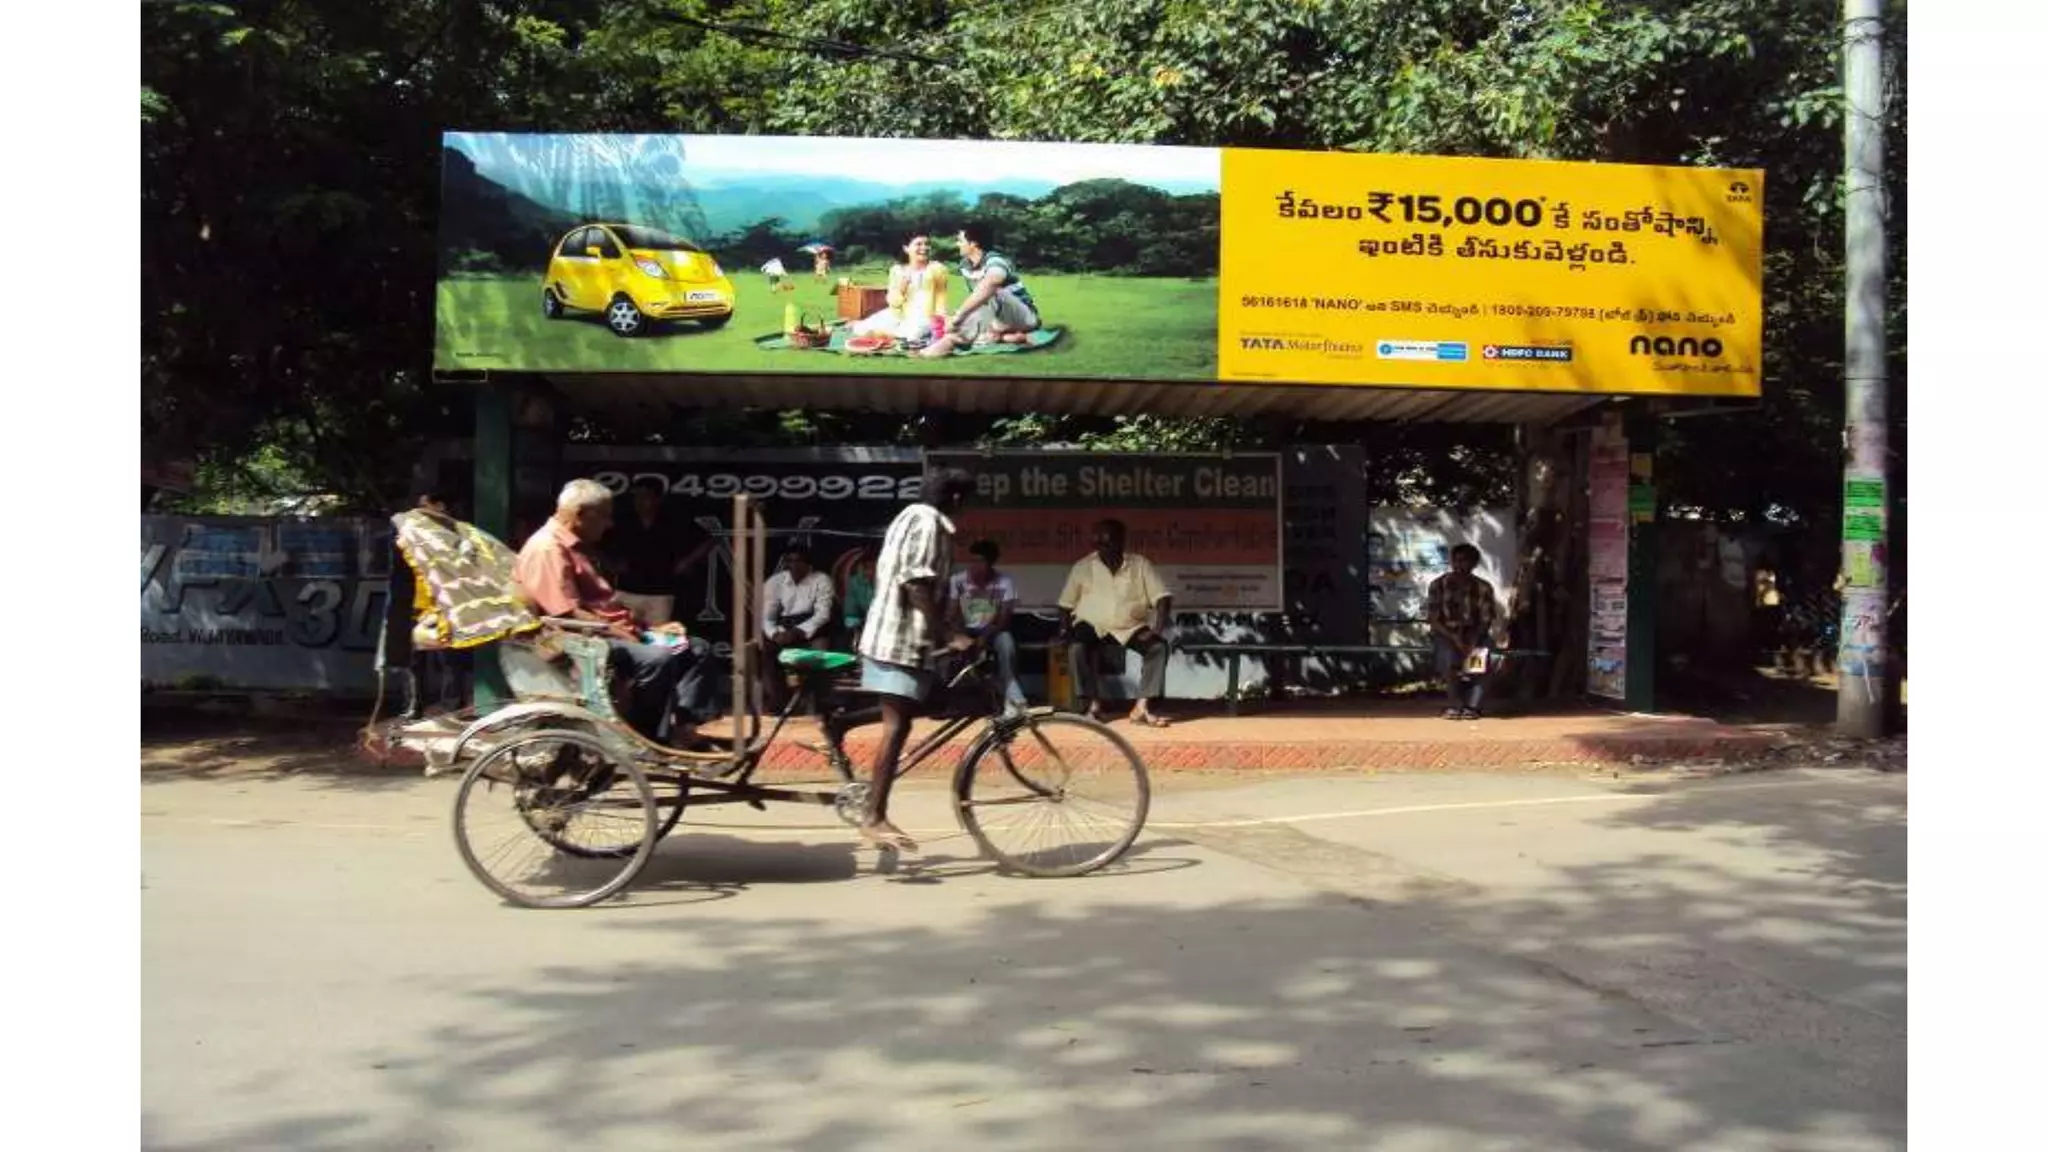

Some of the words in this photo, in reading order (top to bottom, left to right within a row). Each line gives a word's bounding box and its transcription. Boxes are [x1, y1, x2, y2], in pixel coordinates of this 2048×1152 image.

[1276, 190, 1362, 220] కేవలం
[1551, 202, 1570, 229] కే
[1582, 206, 1719, 246] సంతోషాన్ని
[1359, 233, 1444, 257] ఇంటికి
[1390, 300, 1422, 312] SMS
[1240, 337, 1284, 350] TATA
[1502, 348, 1533, 358] HDFC
[1535, 349, 1569, 359] BANK
[1630, 335, 1724, 358] nano
[1020, 466, 1069, 496] the
[1078, 466, 1184, 497] Shelter
[1193, 466, 1276, 497] Clean
